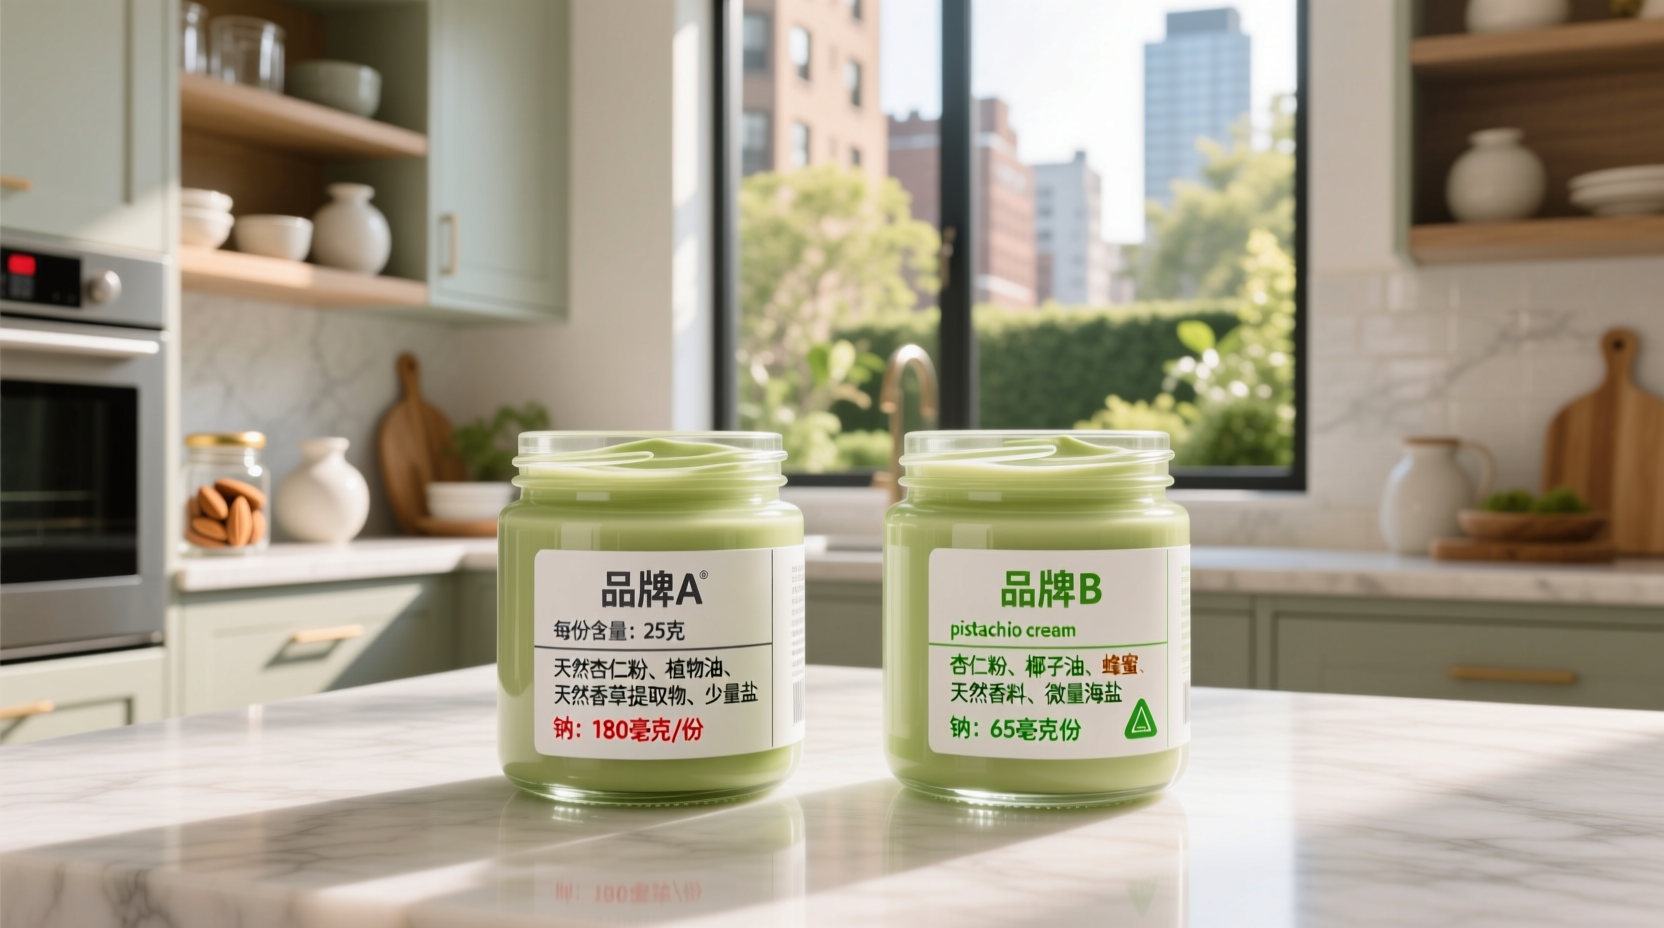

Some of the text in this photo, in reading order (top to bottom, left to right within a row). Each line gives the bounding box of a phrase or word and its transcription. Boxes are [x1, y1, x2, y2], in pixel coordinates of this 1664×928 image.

[1001, 570, 1102, 608] 品牌B
[951, 620, 1076, 640] pistachio cream
